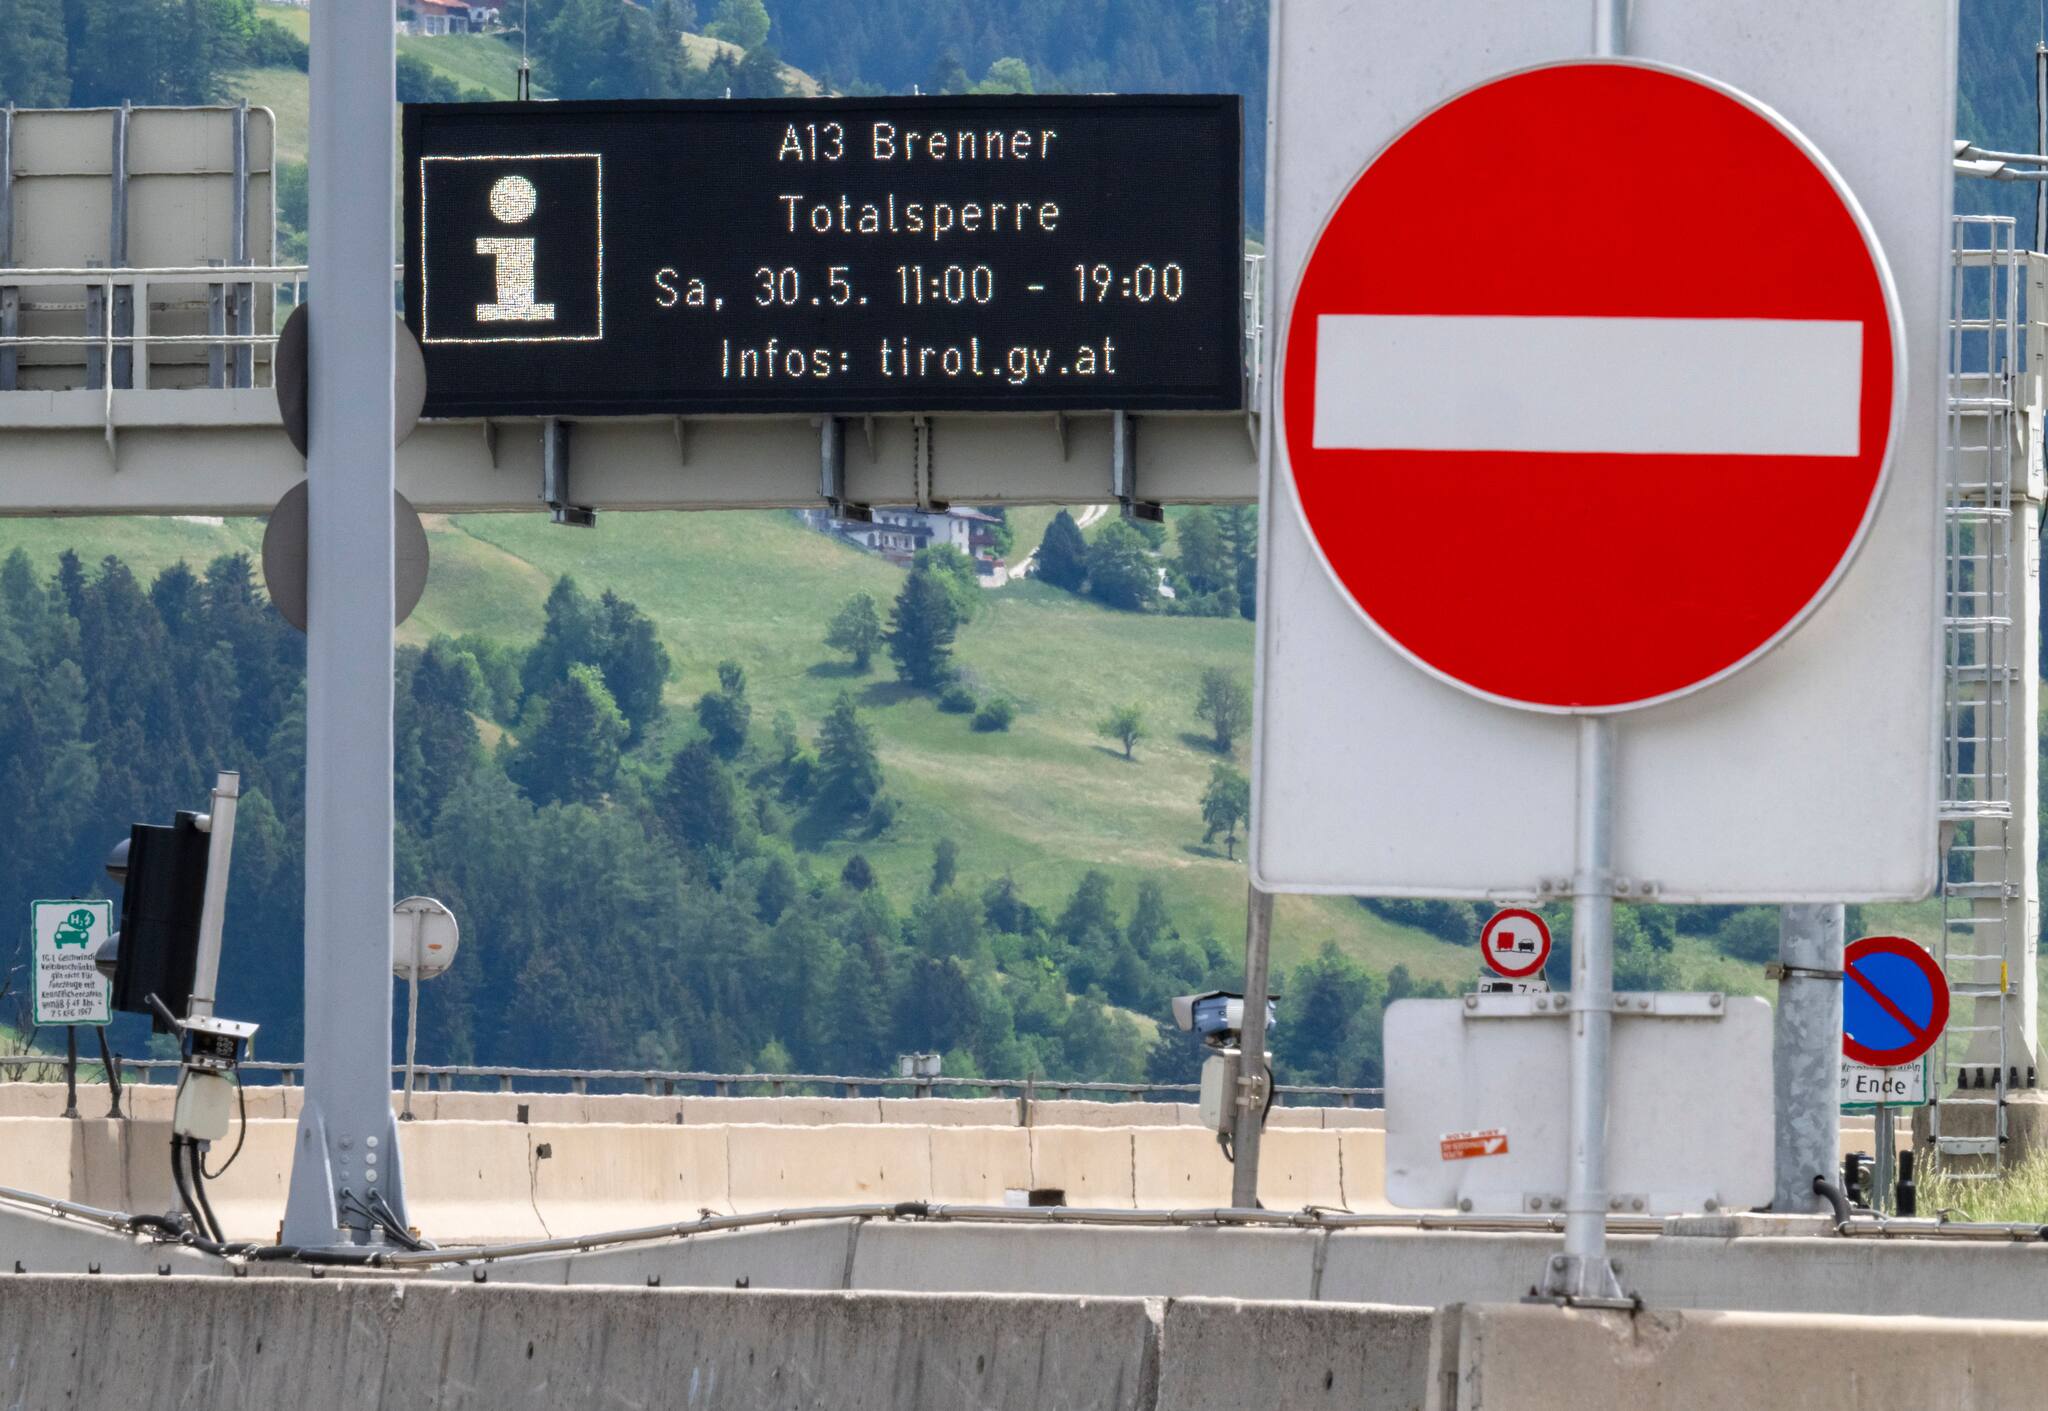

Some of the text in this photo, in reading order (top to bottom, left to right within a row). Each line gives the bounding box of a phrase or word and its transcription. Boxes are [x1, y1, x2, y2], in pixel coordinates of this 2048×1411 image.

[778, 122, 1057, 160] A13 Brenner
[779, 193, 1060, 240] Totalsperre
[753, 265, 868, 306] 30.5.
[897, 264, 996, 305] 11:00
[1075, 263, 1183, 303] 19:00
[722, 336, 1116, 384] Infos: tirol.gv.at
[1855, 1074, 1907, 1096] Ende
